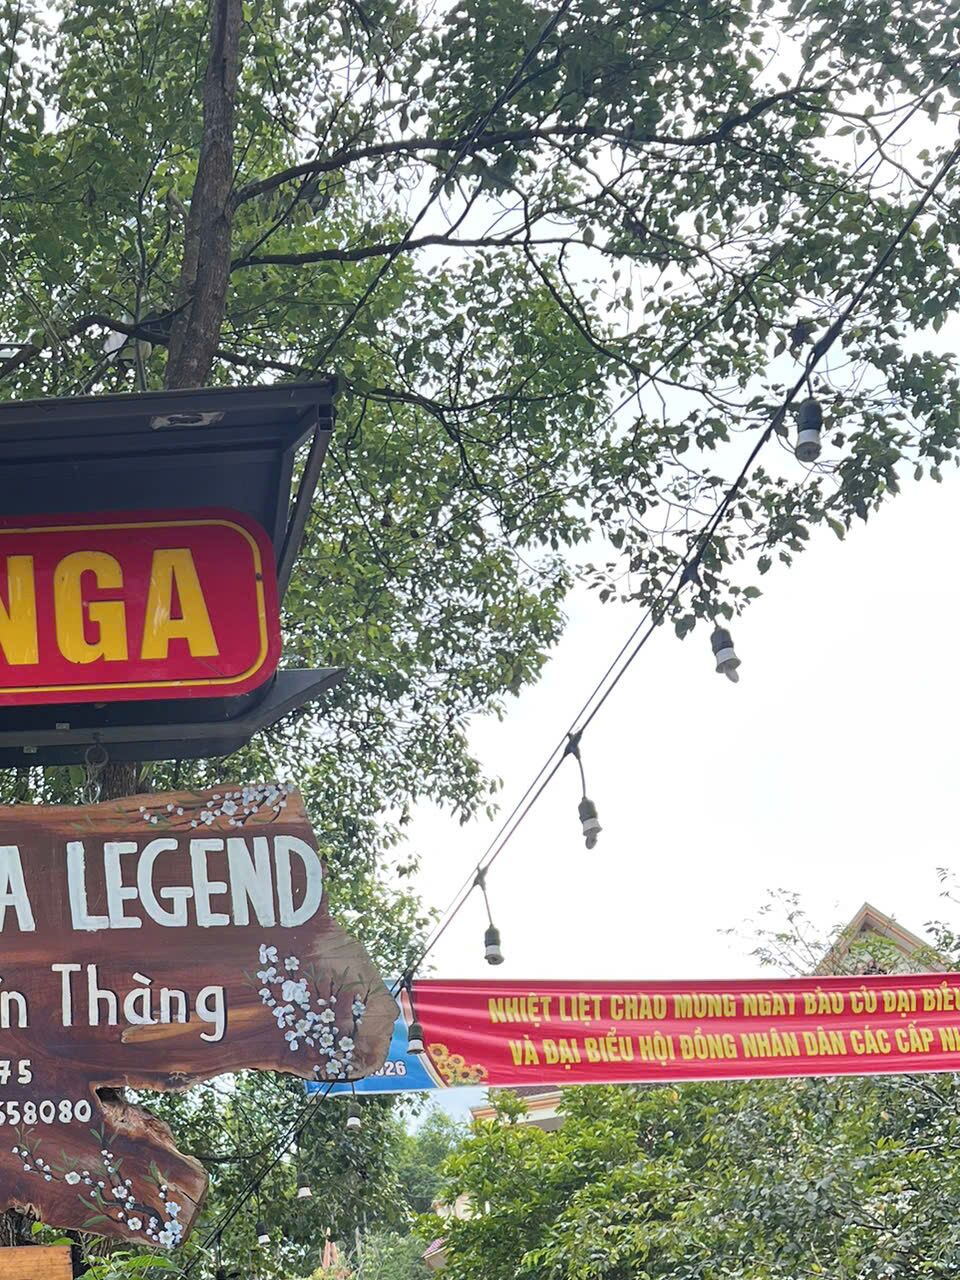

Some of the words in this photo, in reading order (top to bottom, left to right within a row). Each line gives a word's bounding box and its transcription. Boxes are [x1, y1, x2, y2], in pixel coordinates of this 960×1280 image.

[66, 835, 325, 931] LEGEND
[50, 962, 227, 1043] Thàng
[489, 992, 551, 1027] NHIỆT
[883, 989, 917, 1018] ĐẠI
[508, 1034, 540, 1066] VÀ
[543, 1038, 581, 1069] ĐẠI
[585, 1027, 634, 1063] BIỂU
[639, 1030, 675, 1066] HỘI
[742, 1027, 801, 1058] NHÂN
[803, 1025, 847, 1056] DÂN
[851, 1025, 891, 1054] CÁC
[895, 1020, 934, 1054] CẤP
